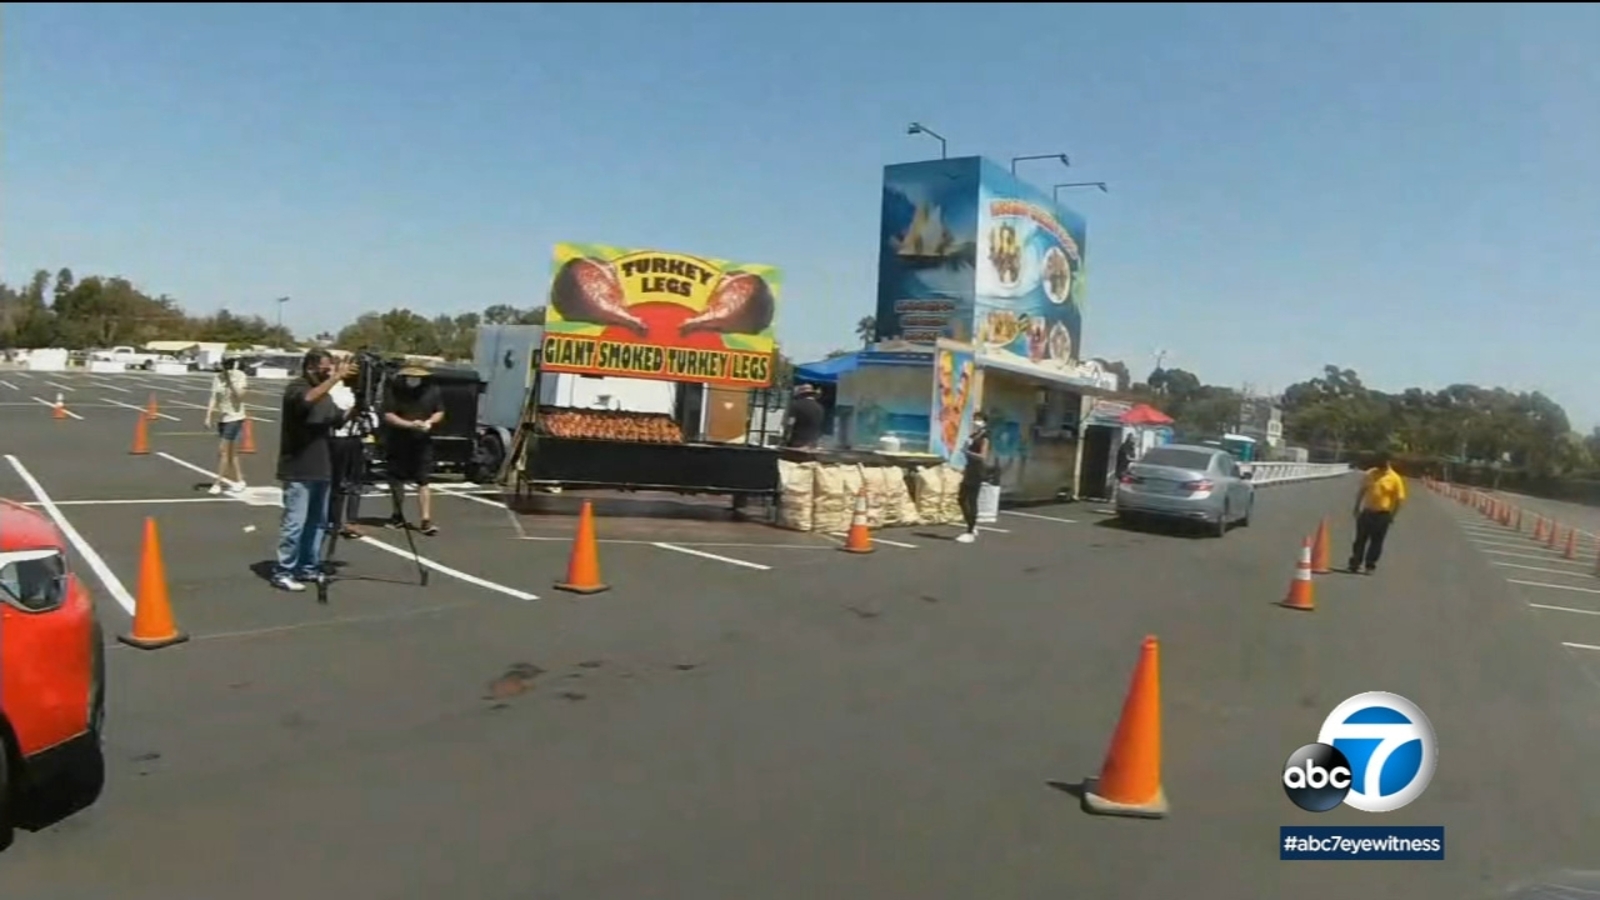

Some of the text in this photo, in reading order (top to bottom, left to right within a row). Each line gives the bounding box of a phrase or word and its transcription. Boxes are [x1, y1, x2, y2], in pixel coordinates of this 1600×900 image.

[622, 258, 713, 284] TURKEY
[642, 278, 692, 297] LEGS
[545, 337, 769, 382] GIANT SMOKED TURKEY LEGS
